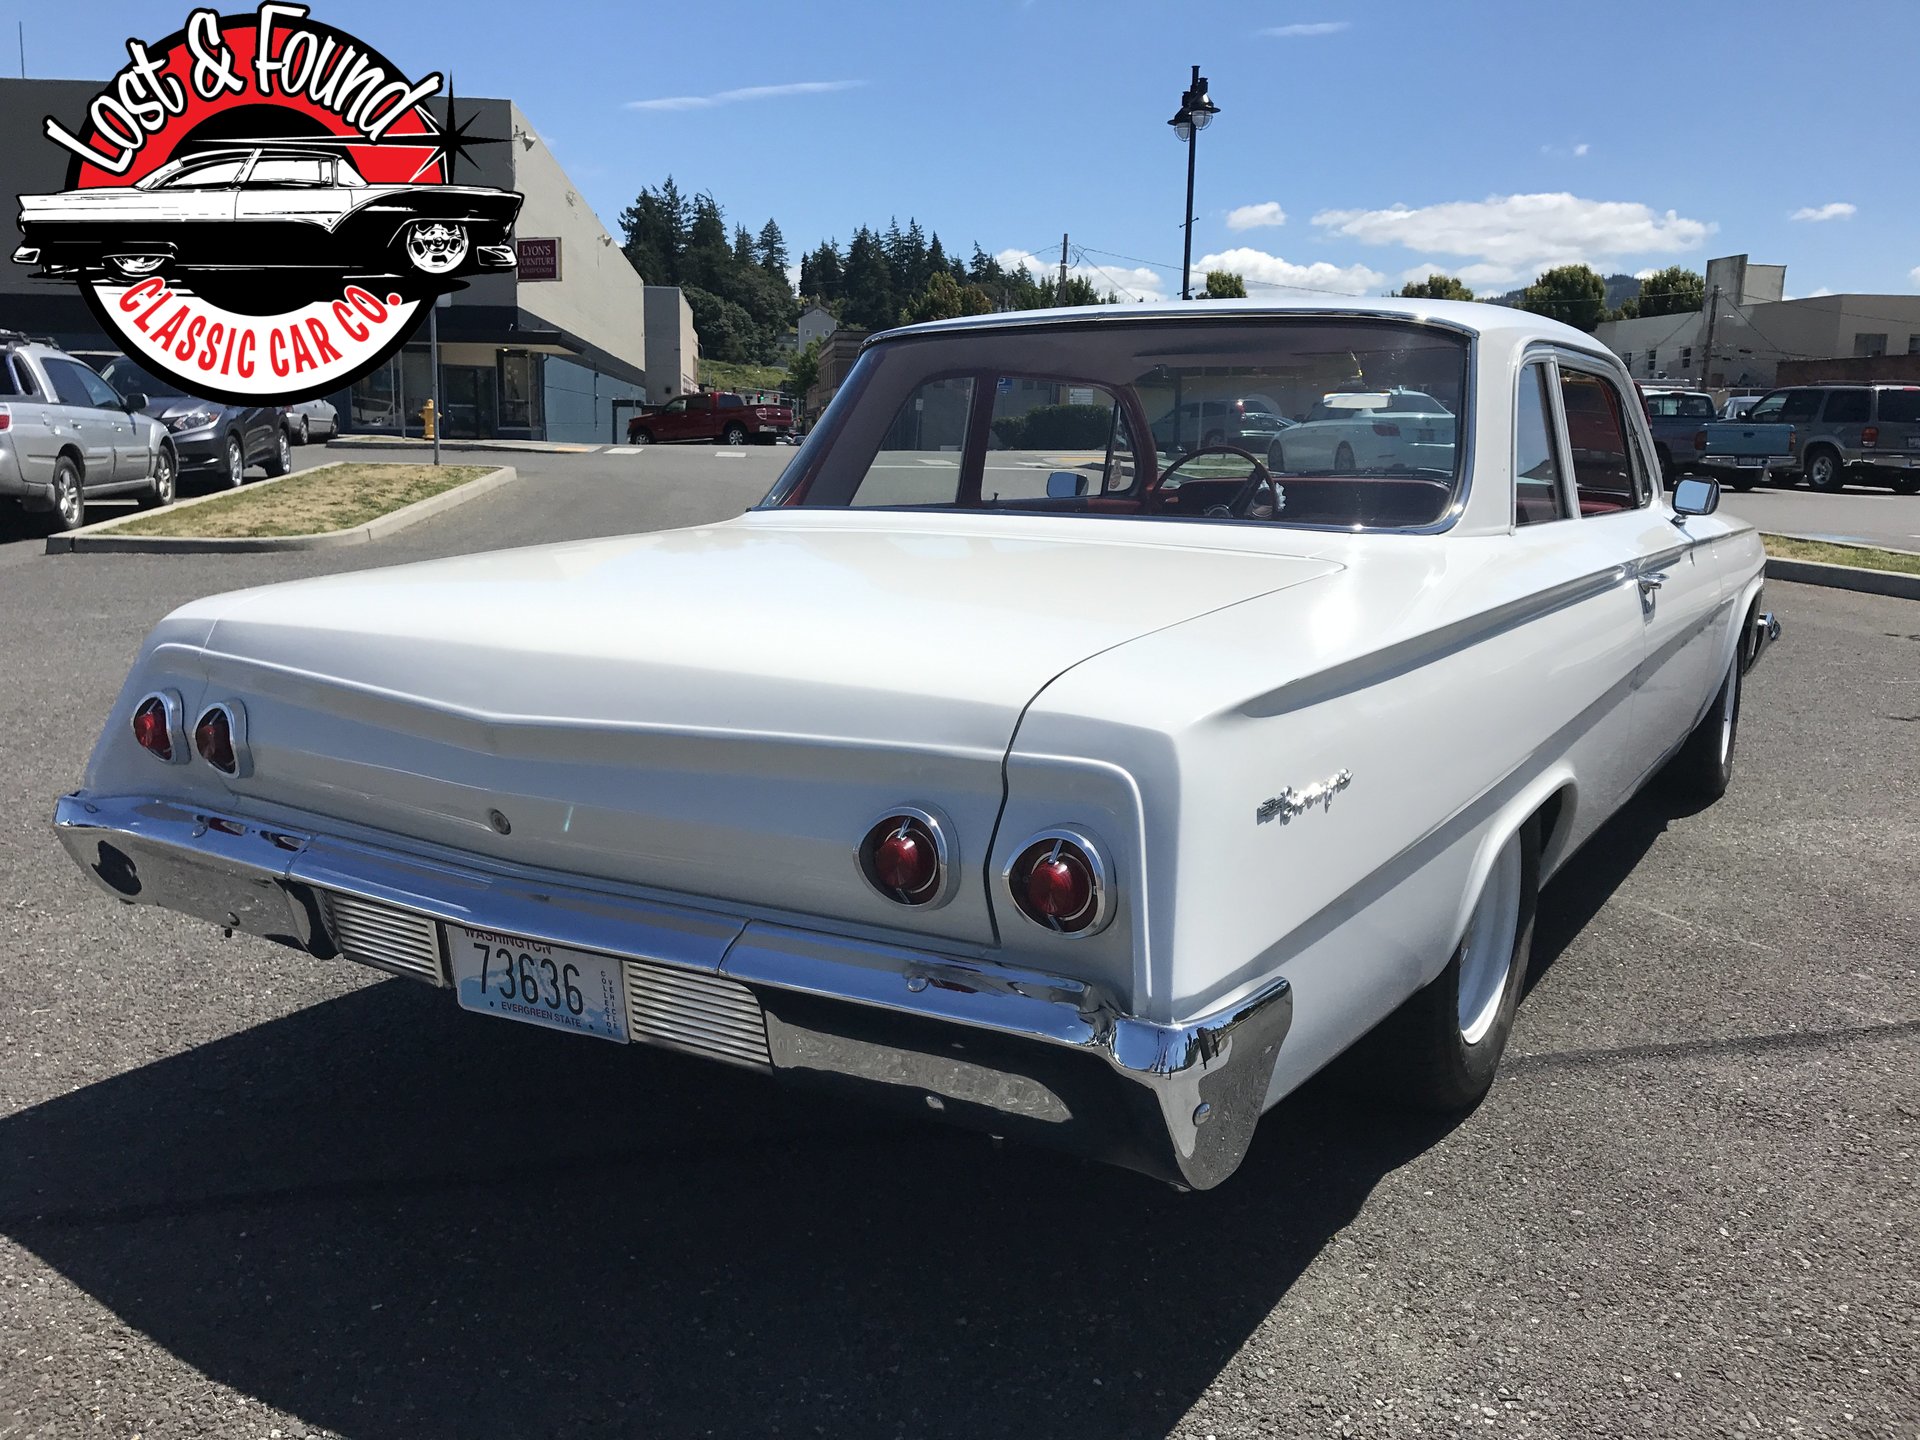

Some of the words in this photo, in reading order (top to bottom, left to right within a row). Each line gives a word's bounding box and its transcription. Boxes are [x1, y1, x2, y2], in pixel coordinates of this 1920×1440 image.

[519, 257, 555, 266] FURNITURE
[473, 942, 584, 1015] 73636
[501, 1001, 552, 1020] EVERGREEN
[554, 1013, 582, 1027] STATE
